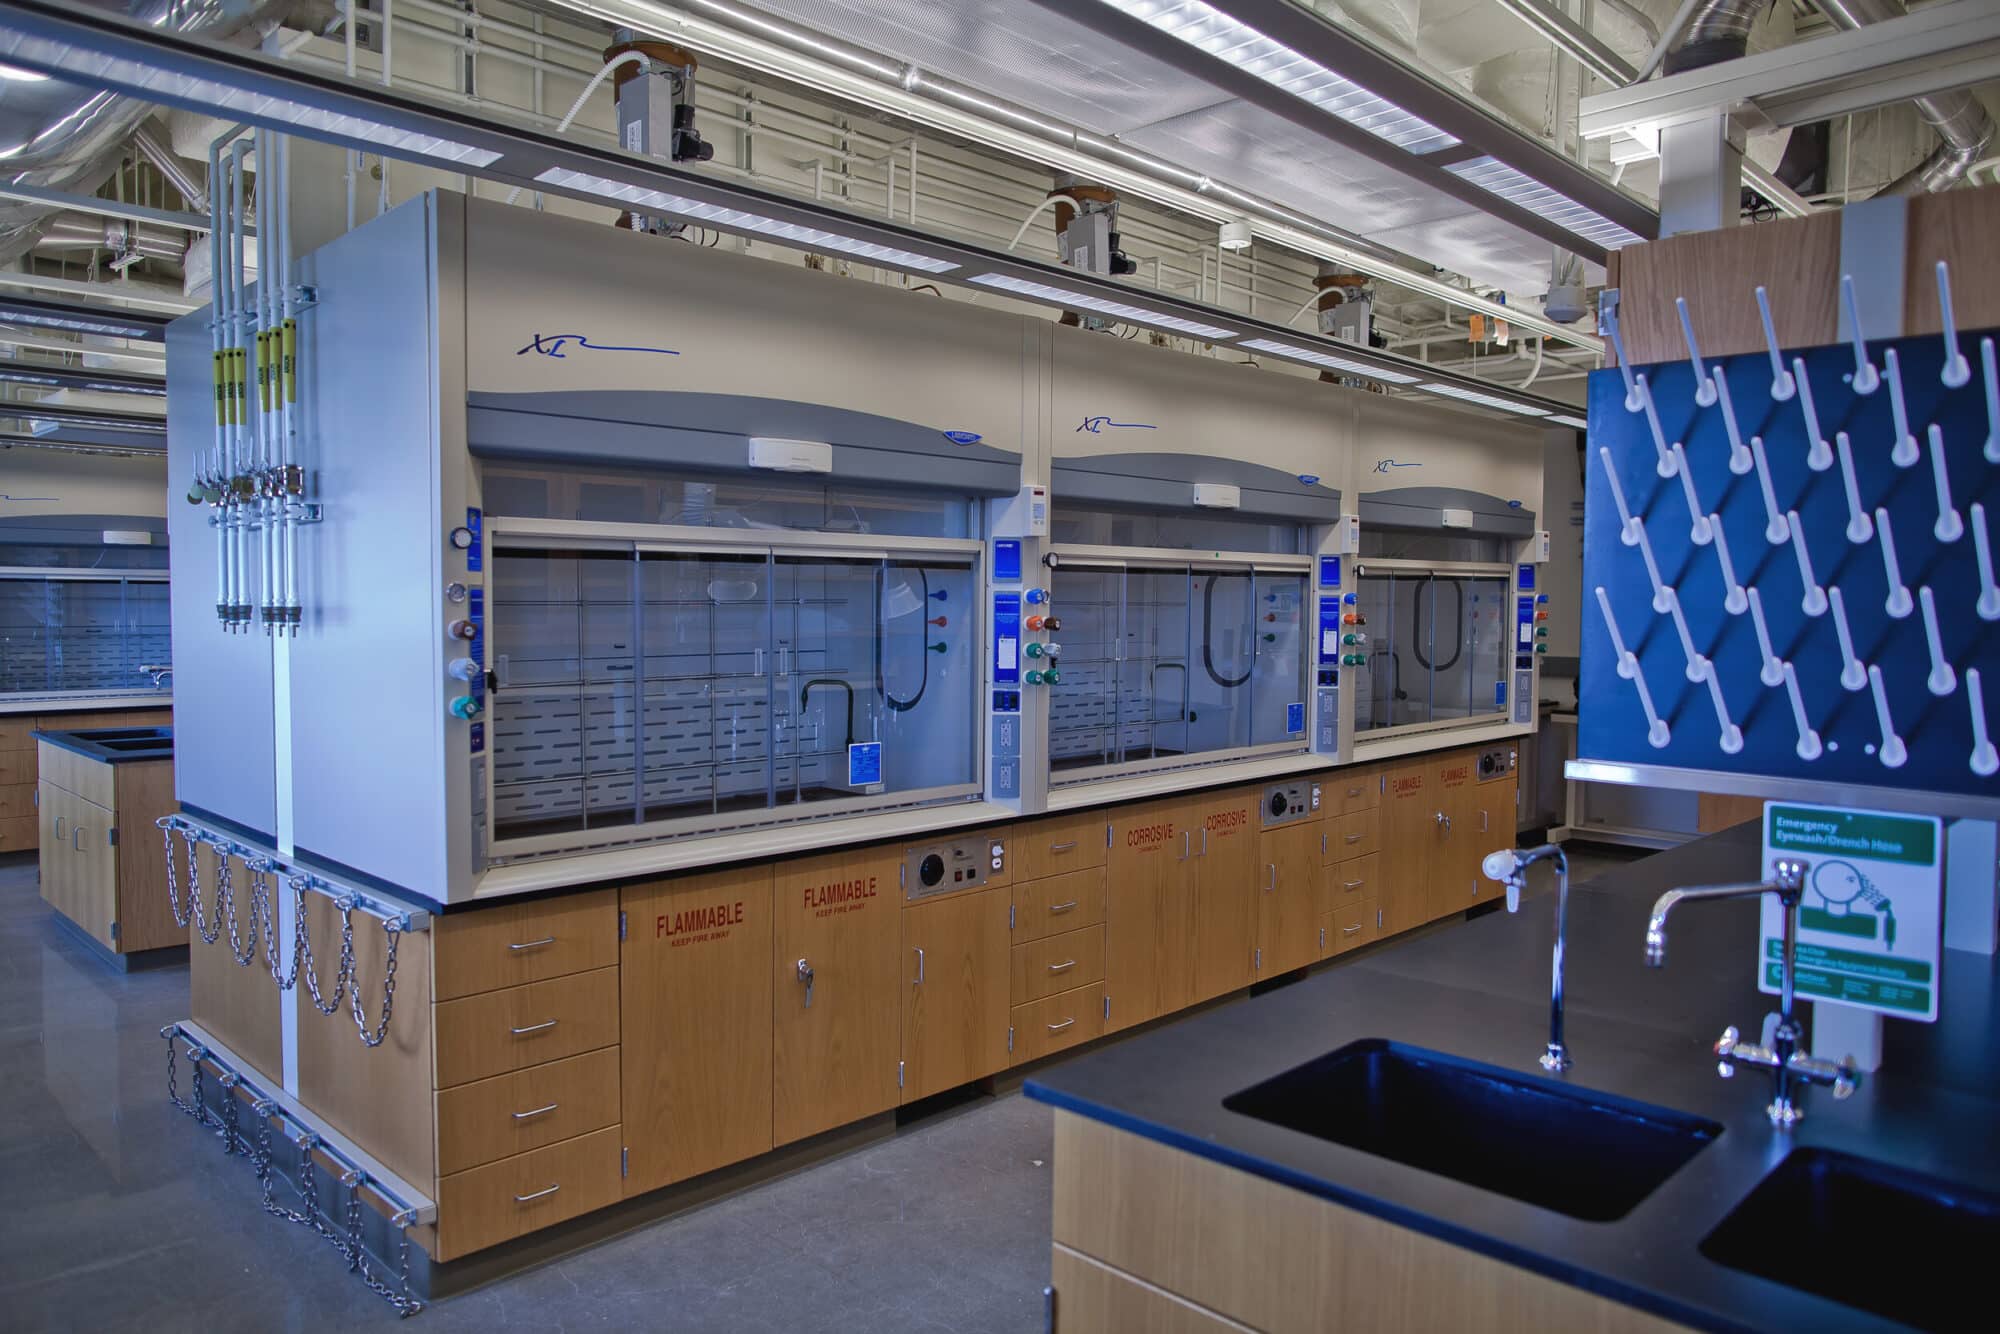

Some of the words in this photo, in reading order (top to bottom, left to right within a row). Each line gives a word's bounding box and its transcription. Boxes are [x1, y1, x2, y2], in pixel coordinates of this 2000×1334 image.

[1206, 809, 1247, 831] CORROSIVE
[1776, 816, 1838, 834] Emergency
[1127, 823, 1173, 847] CORROSIVE
[1776, 829, 1870, 850] Eyewash/Drench
[1871, 839, 1903, 854] Hose
[804, 877, 877, 909] FLAMMABLE
[656, 902, 743, 938] FLAMMABLE
[816, 908, 832, 918] KEEP
[833, 905, 848, 915] FIRE
[849, 902, 865, 912] AWAY
[671, 937, 691, 947] KEEP
[692, 934, 708, 944] FIRE
[710, 930, 730, 941] AWAY
